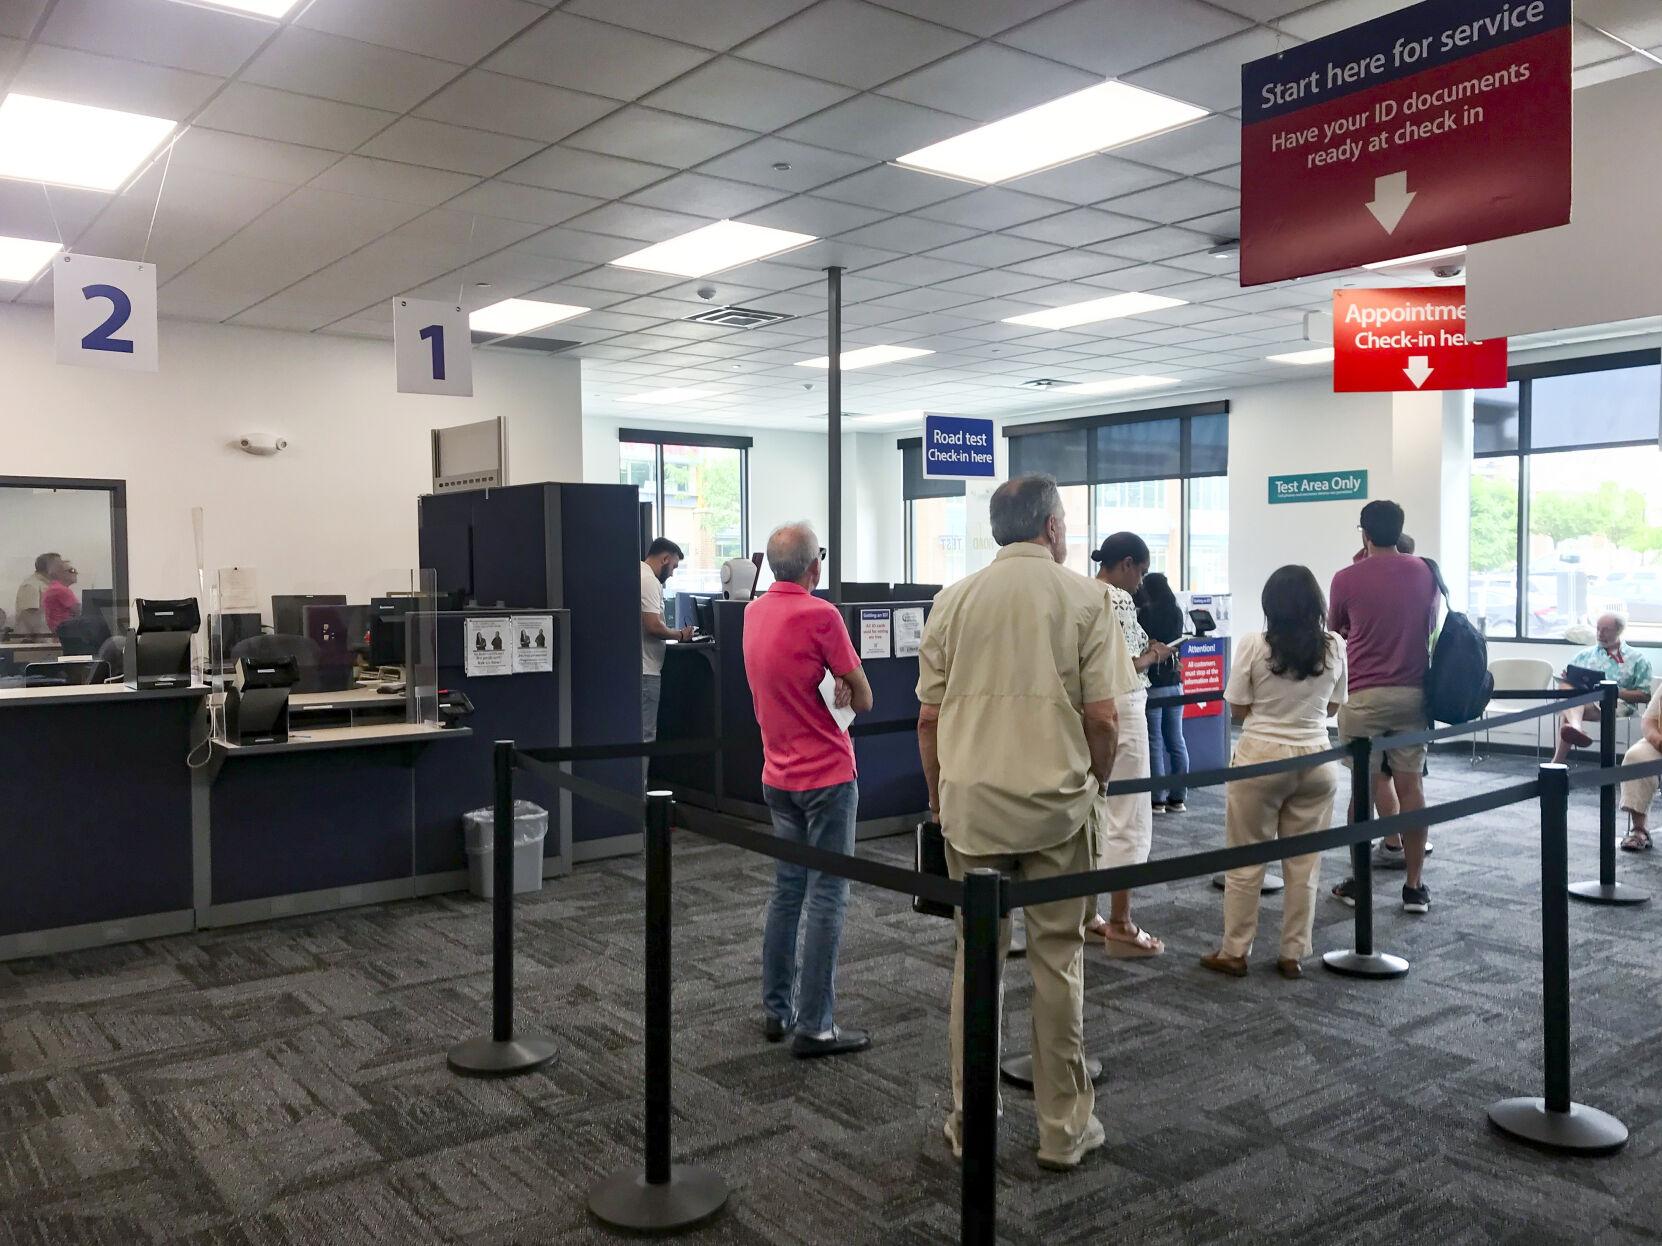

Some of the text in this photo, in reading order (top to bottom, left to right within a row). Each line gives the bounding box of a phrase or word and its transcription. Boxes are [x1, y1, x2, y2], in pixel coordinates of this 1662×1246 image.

[1261, 0, 1545, 108] Start here for service
[1271, 61, 1530, 152] Have your ID documents
[1307, 104, 1484, 168] ready at check in
[81, 284, 134, 354] 2
[1344, 302, 1466, 327] Appointme
[1355, 330, 1436, 349] Check-in
[419, 324, 446, 380] 1
[934, 430, 987, 446] Road test
[928, 449, 993, 463] Check-in here
[1275, 476, 1361, 493] Test Area Only
[1188, 644, 1216, 654] Attention!
[1194, 660, 1216, 668] customers
